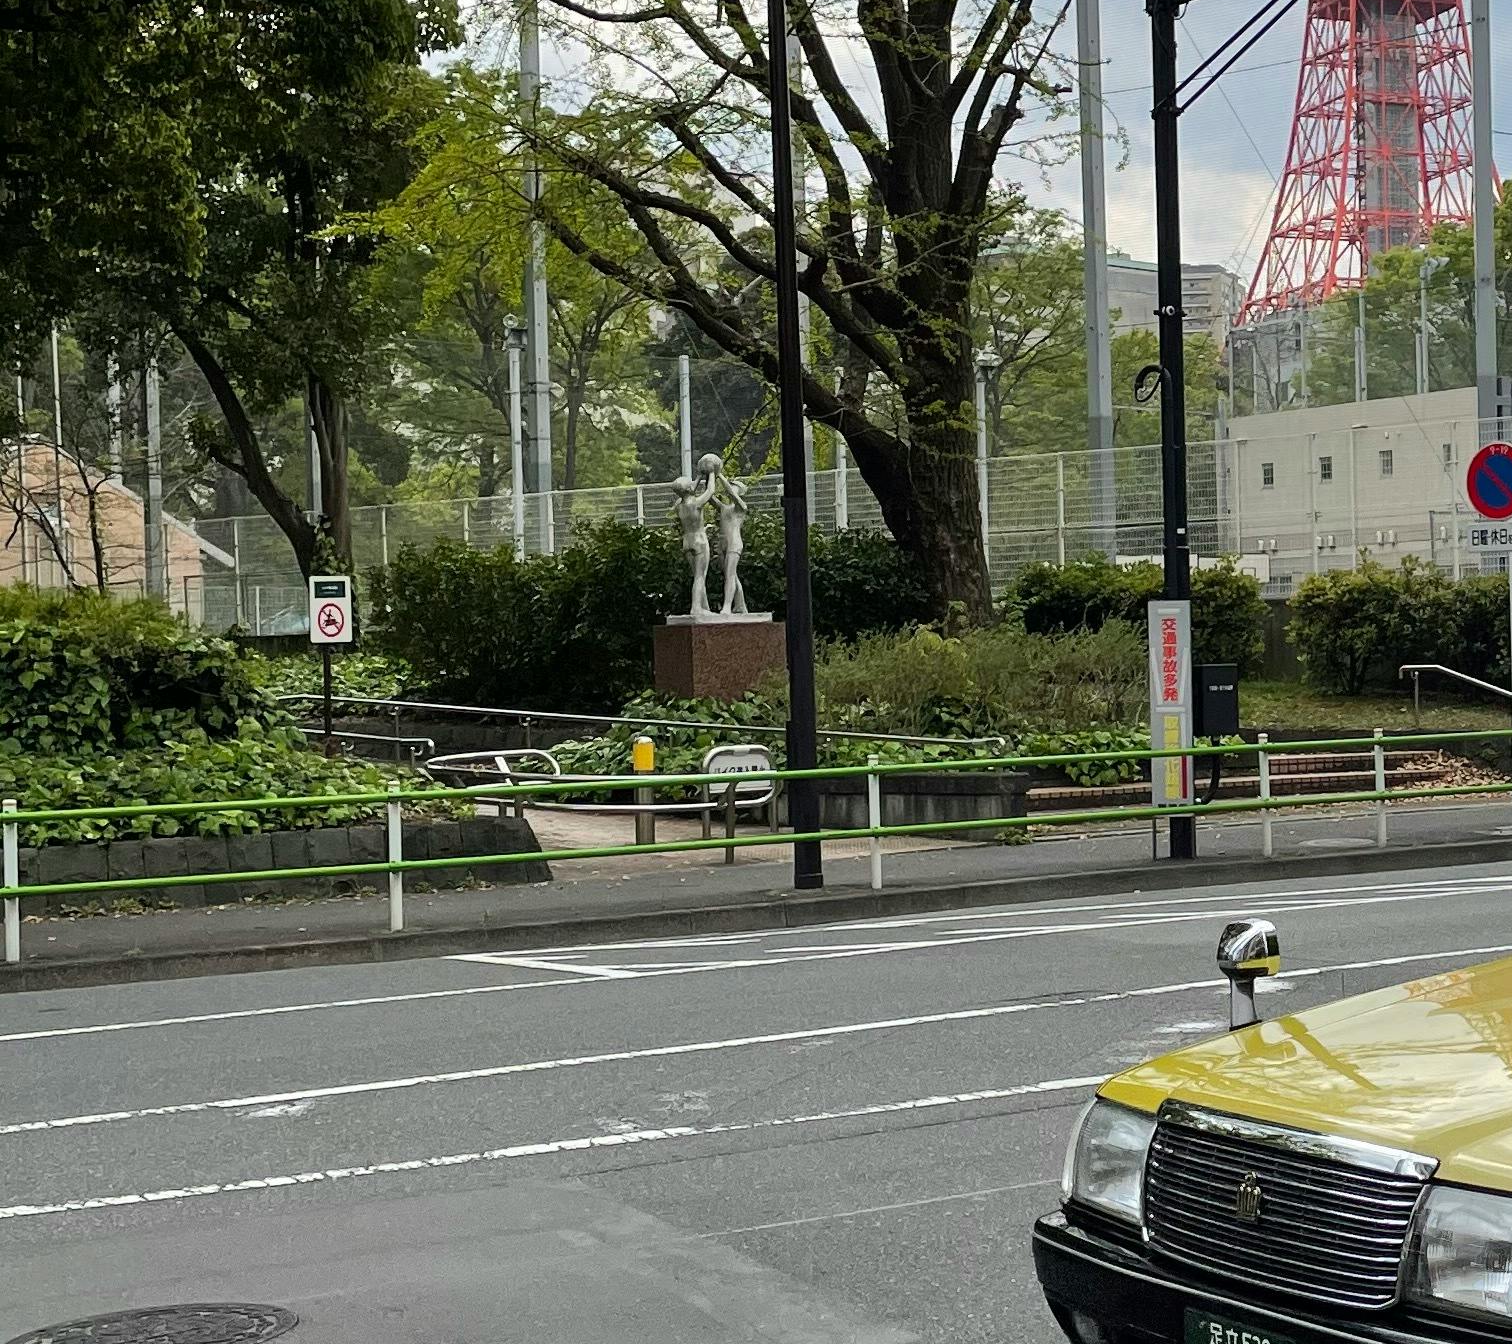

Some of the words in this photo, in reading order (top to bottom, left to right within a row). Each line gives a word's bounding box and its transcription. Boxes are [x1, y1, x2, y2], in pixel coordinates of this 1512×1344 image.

[1161, 618, 1179, 702] 交通事故多発
